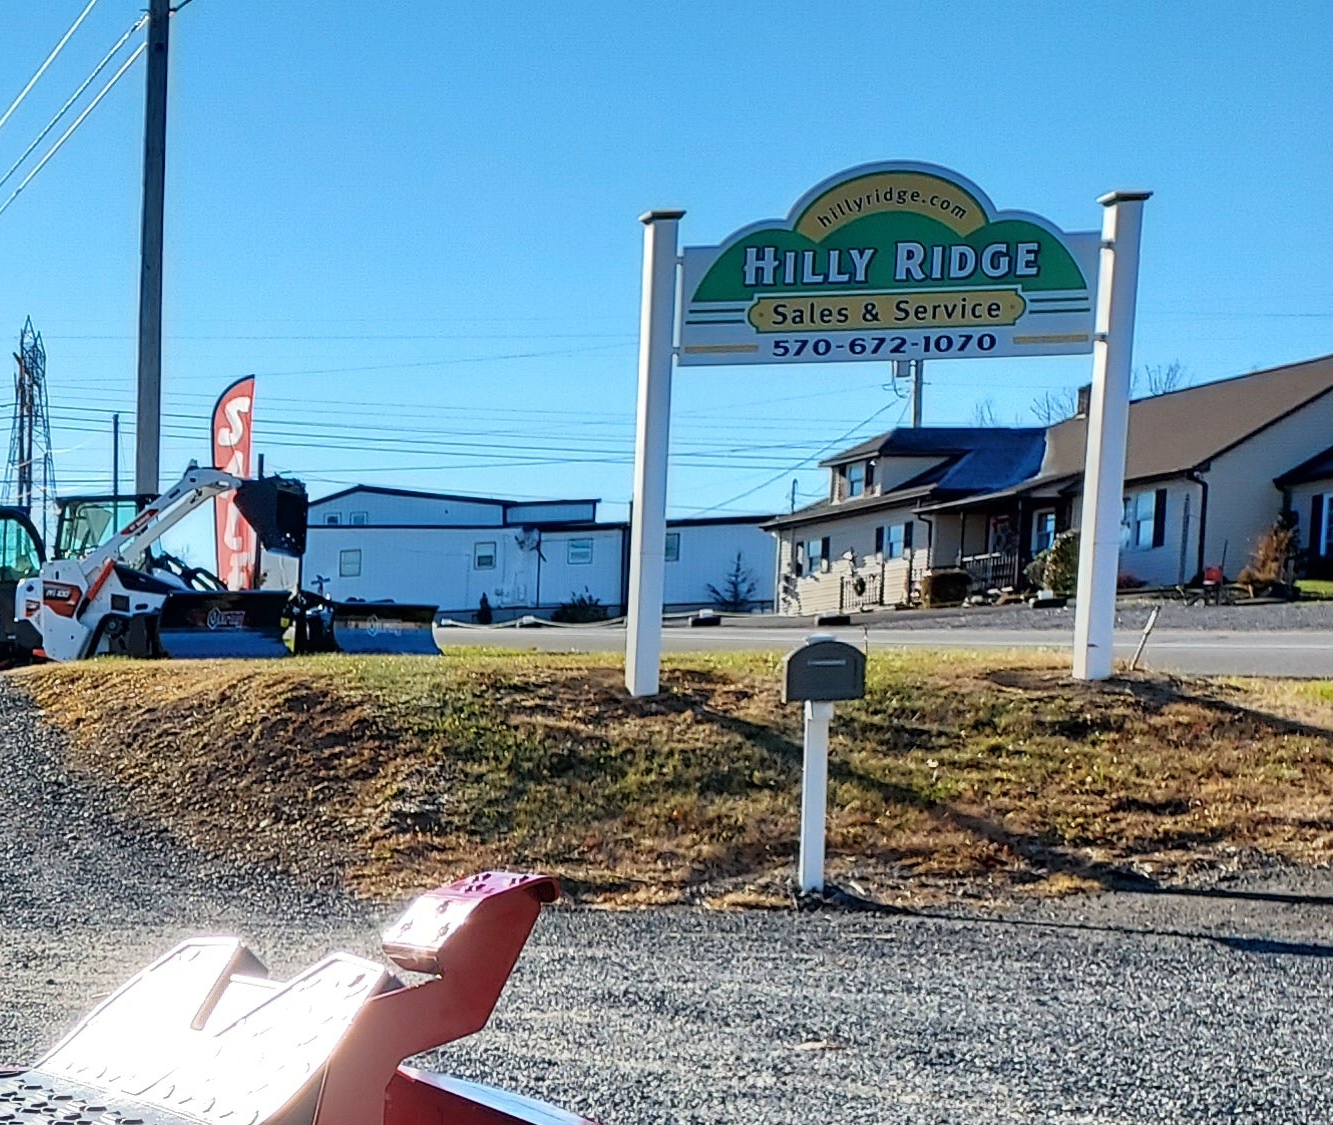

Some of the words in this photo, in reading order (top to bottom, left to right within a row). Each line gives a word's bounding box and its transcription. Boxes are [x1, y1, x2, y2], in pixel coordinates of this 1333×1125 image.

[817, 187, 967, 228] hillyridge.com
[771, 303, 849, 325] Sales
[861, 301, 881, 322] &
[894, 297, 1001, 321] Service
[771, 332, 997, 357] 570-672-1070
